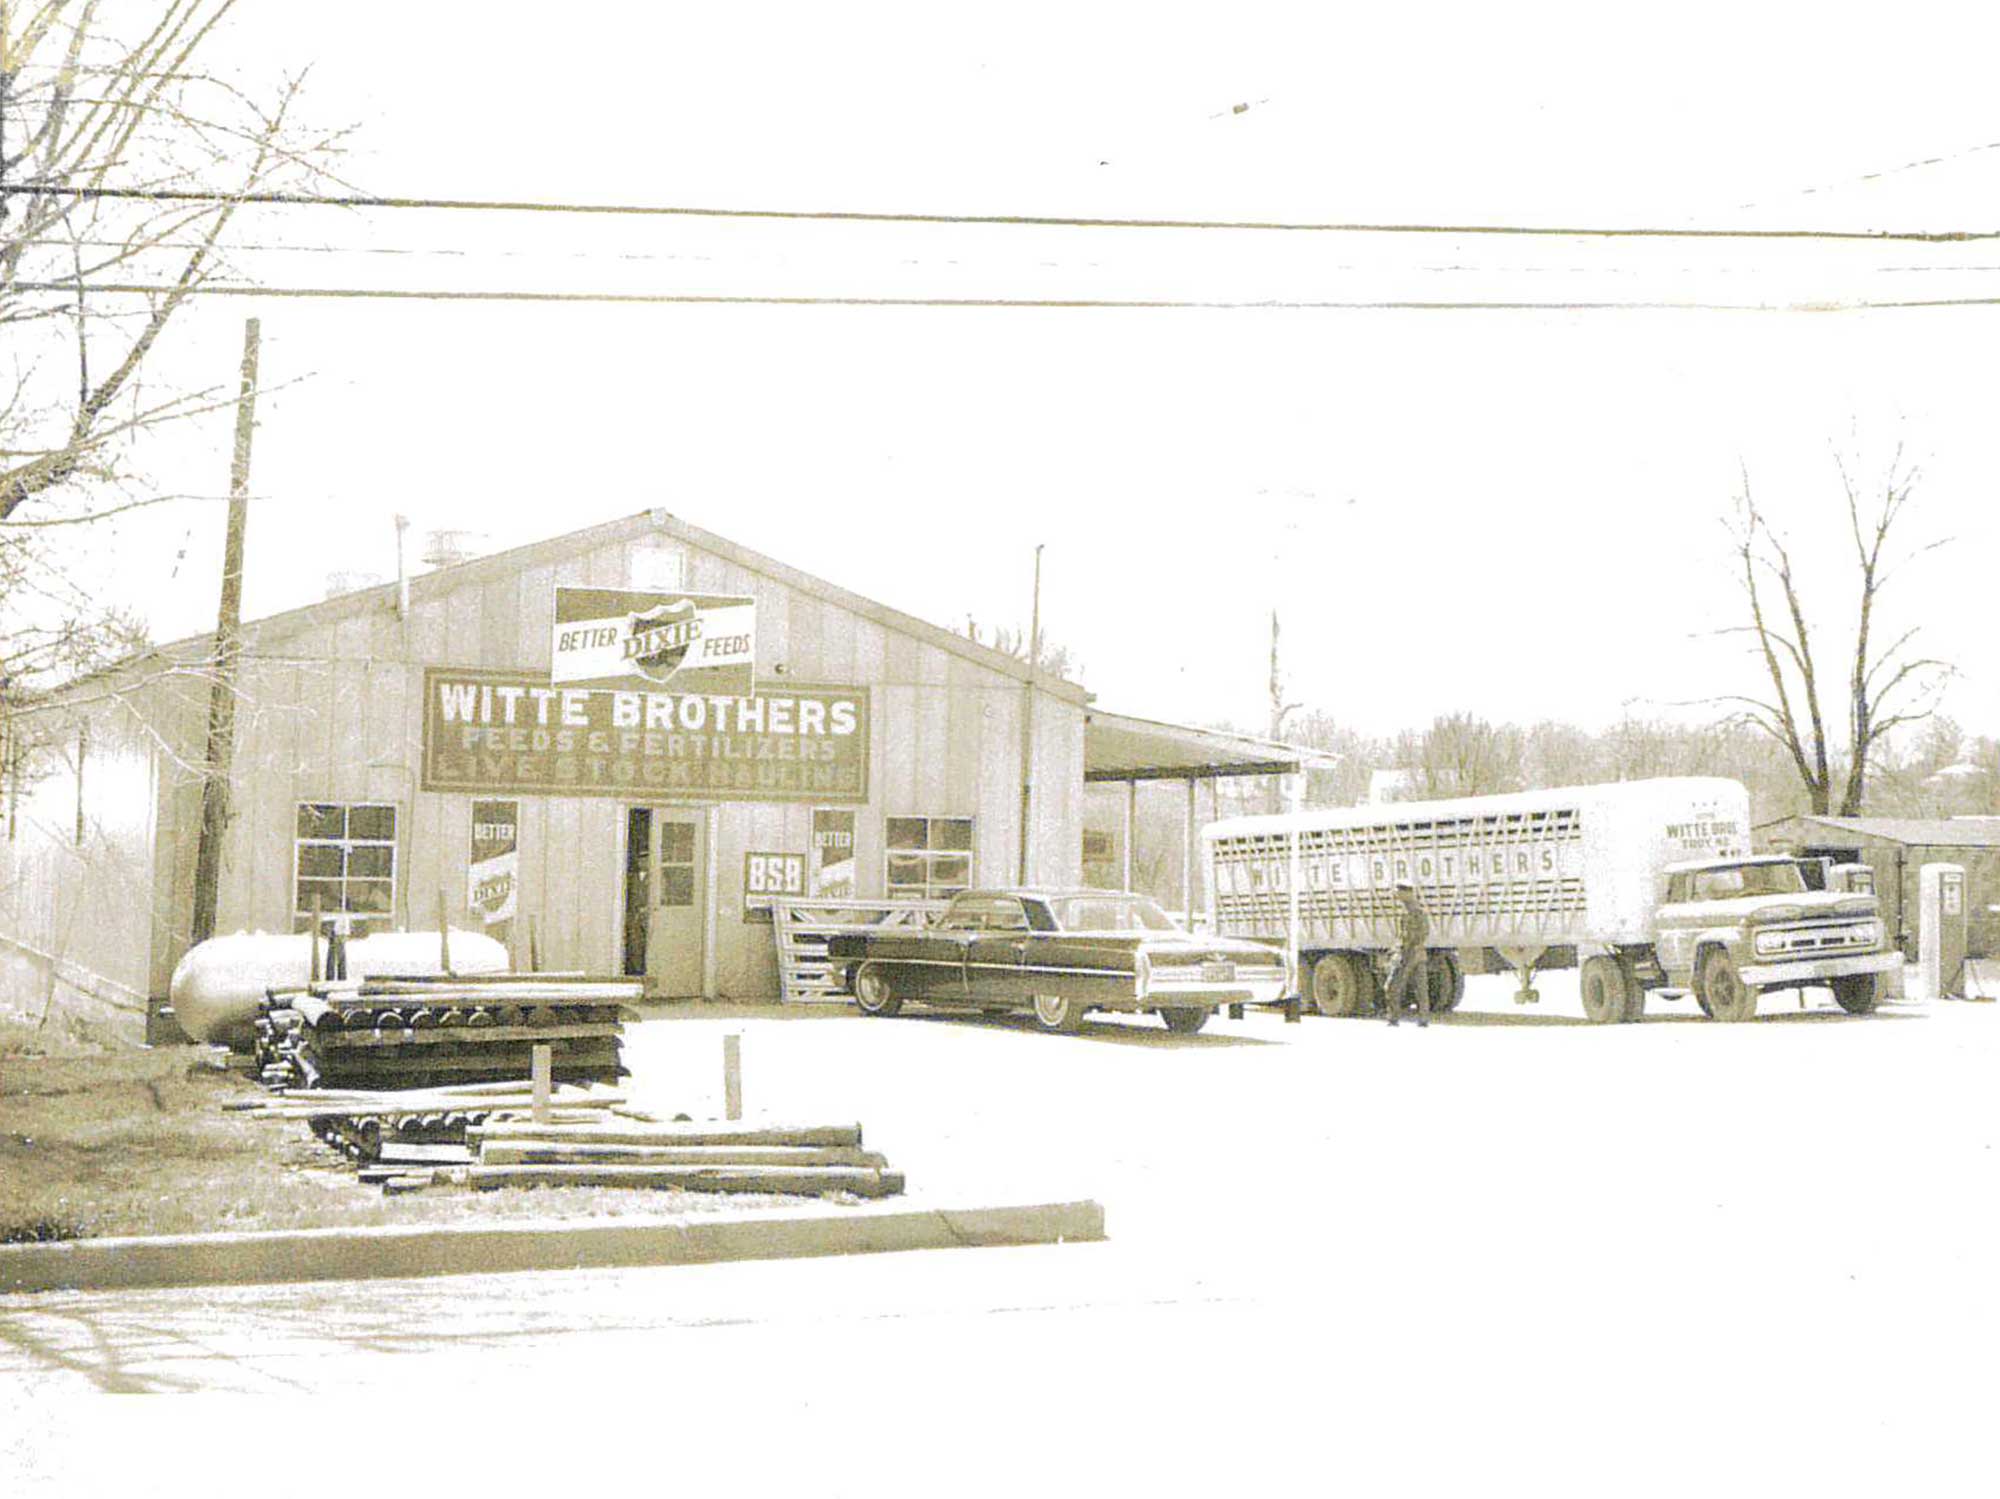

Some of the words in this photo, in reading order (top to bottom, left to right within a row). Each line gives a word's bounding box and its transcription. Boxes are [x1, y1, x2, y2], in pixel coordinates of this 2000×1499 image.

[558, 628, 618, 652] BETTER
[622, 618, 704, 661] DIXIE
[702, 633, 751, 658] FEEDS
[440, 683, 590, 727] WITTE
[612, 693, 858, 736] BROTHERS
[462, 727, 574, 752] FEEDS
[588, 731, 610, 753] &
[619, 732, 837, 761] FERTILIZERS
[474, 822, 515, 840] BETTER
[814, 831, 852, 849] BETTER
[1666, 822, 1708, 838] WITTE
[1252, 863, 1342, 887] WITE
[1373, 850, 1553, 882] BROTHERS
